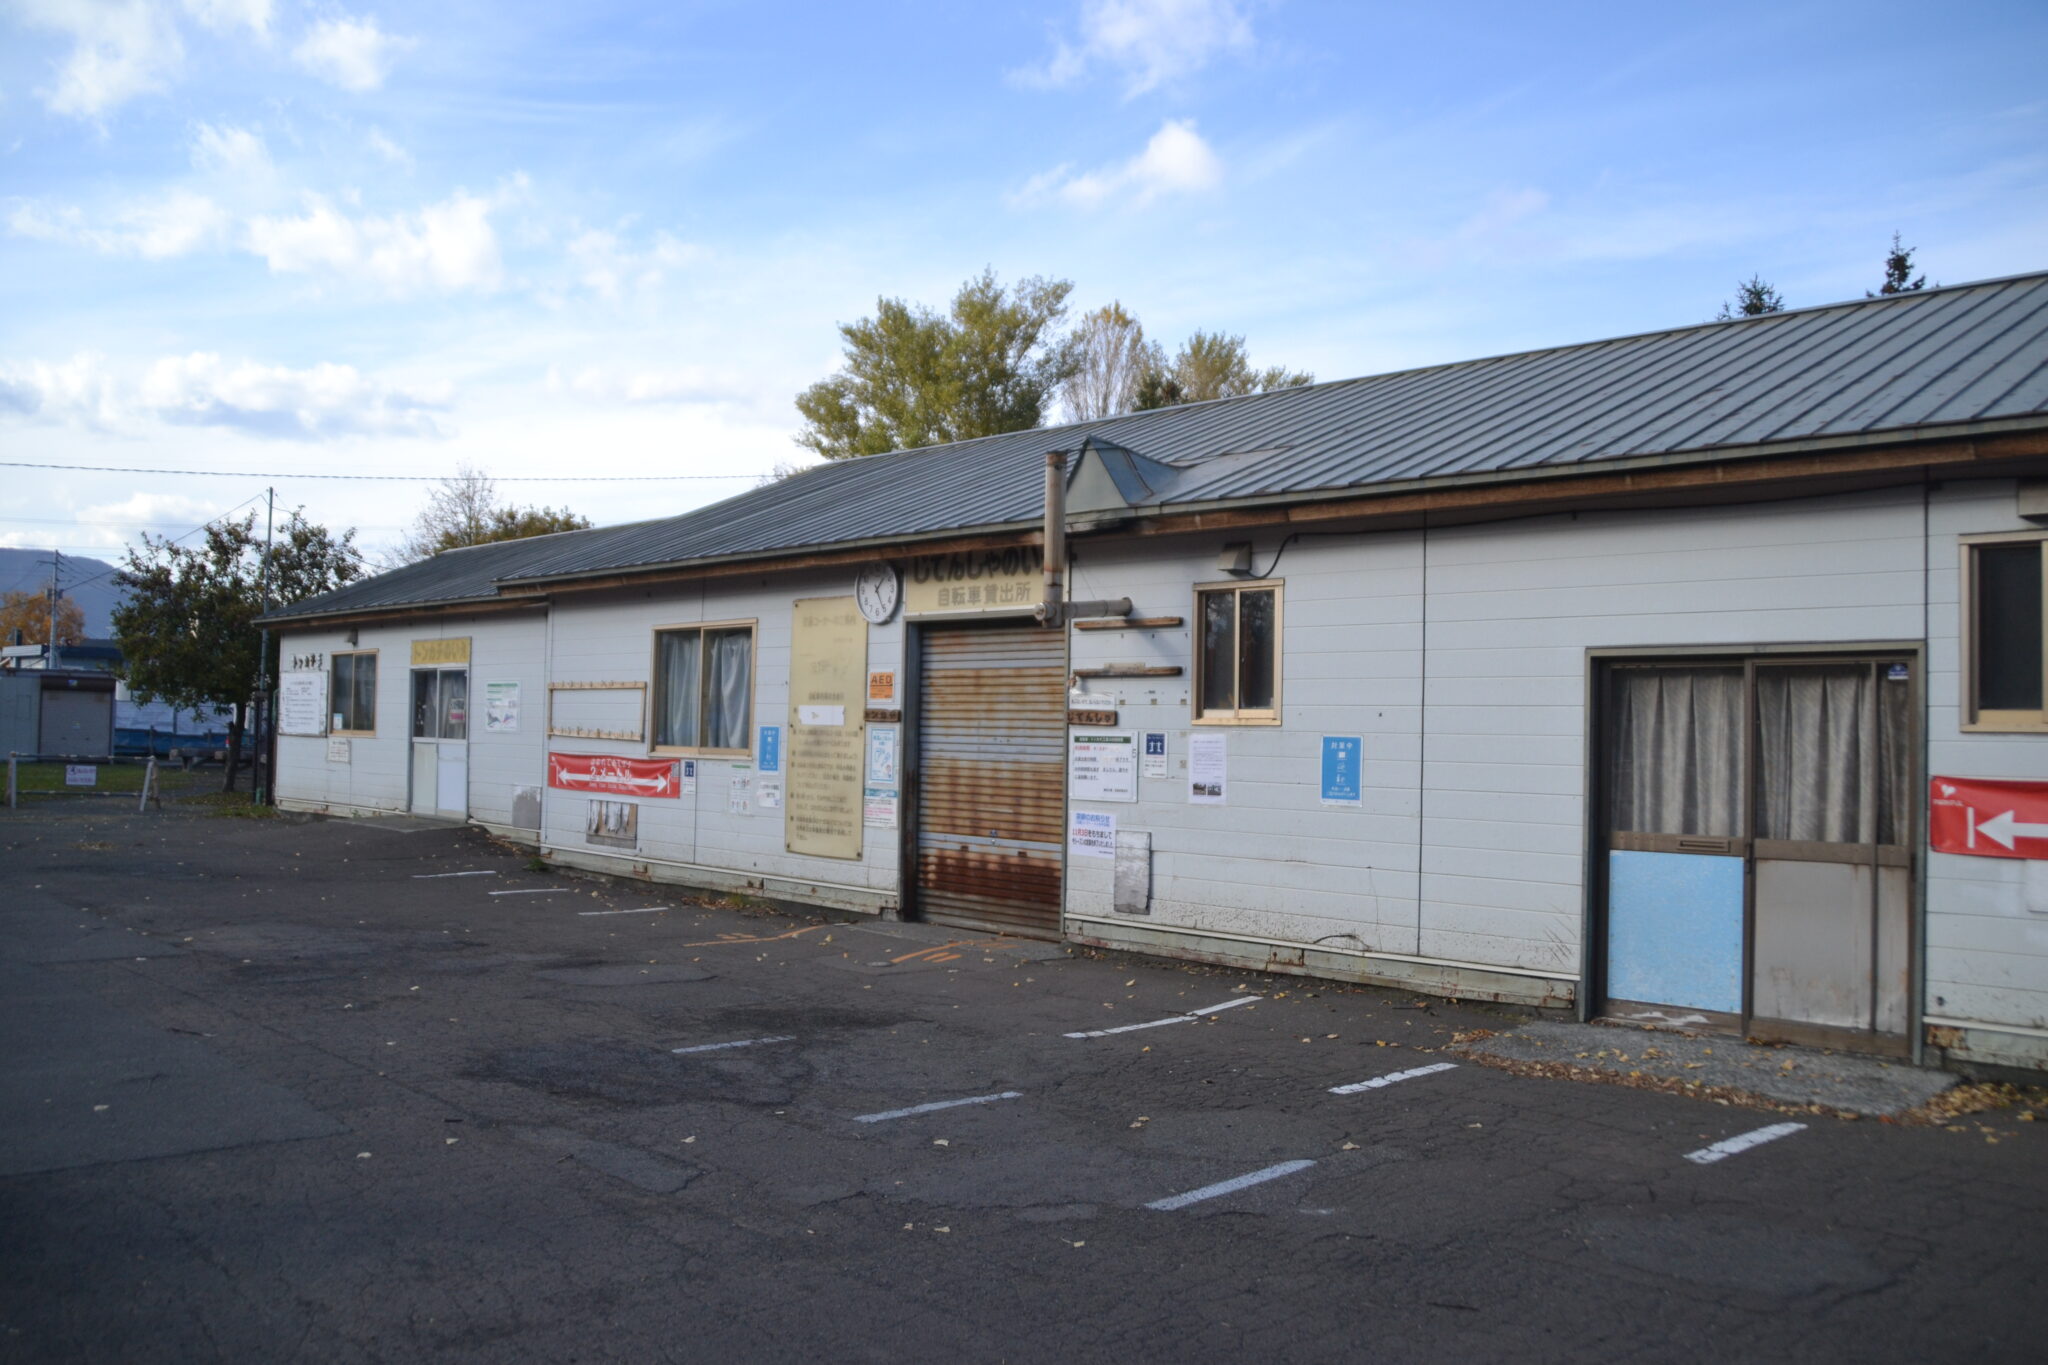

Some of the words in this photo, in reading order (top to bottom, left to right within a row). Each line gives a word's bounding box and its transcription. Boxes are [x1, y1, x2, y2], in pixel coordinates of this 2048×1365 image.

[913, 546, 1044, 584] じてんしゃのい
[871, 675, 893, 685] AED
[1076, 812, 1111, 823] のお知らせ
